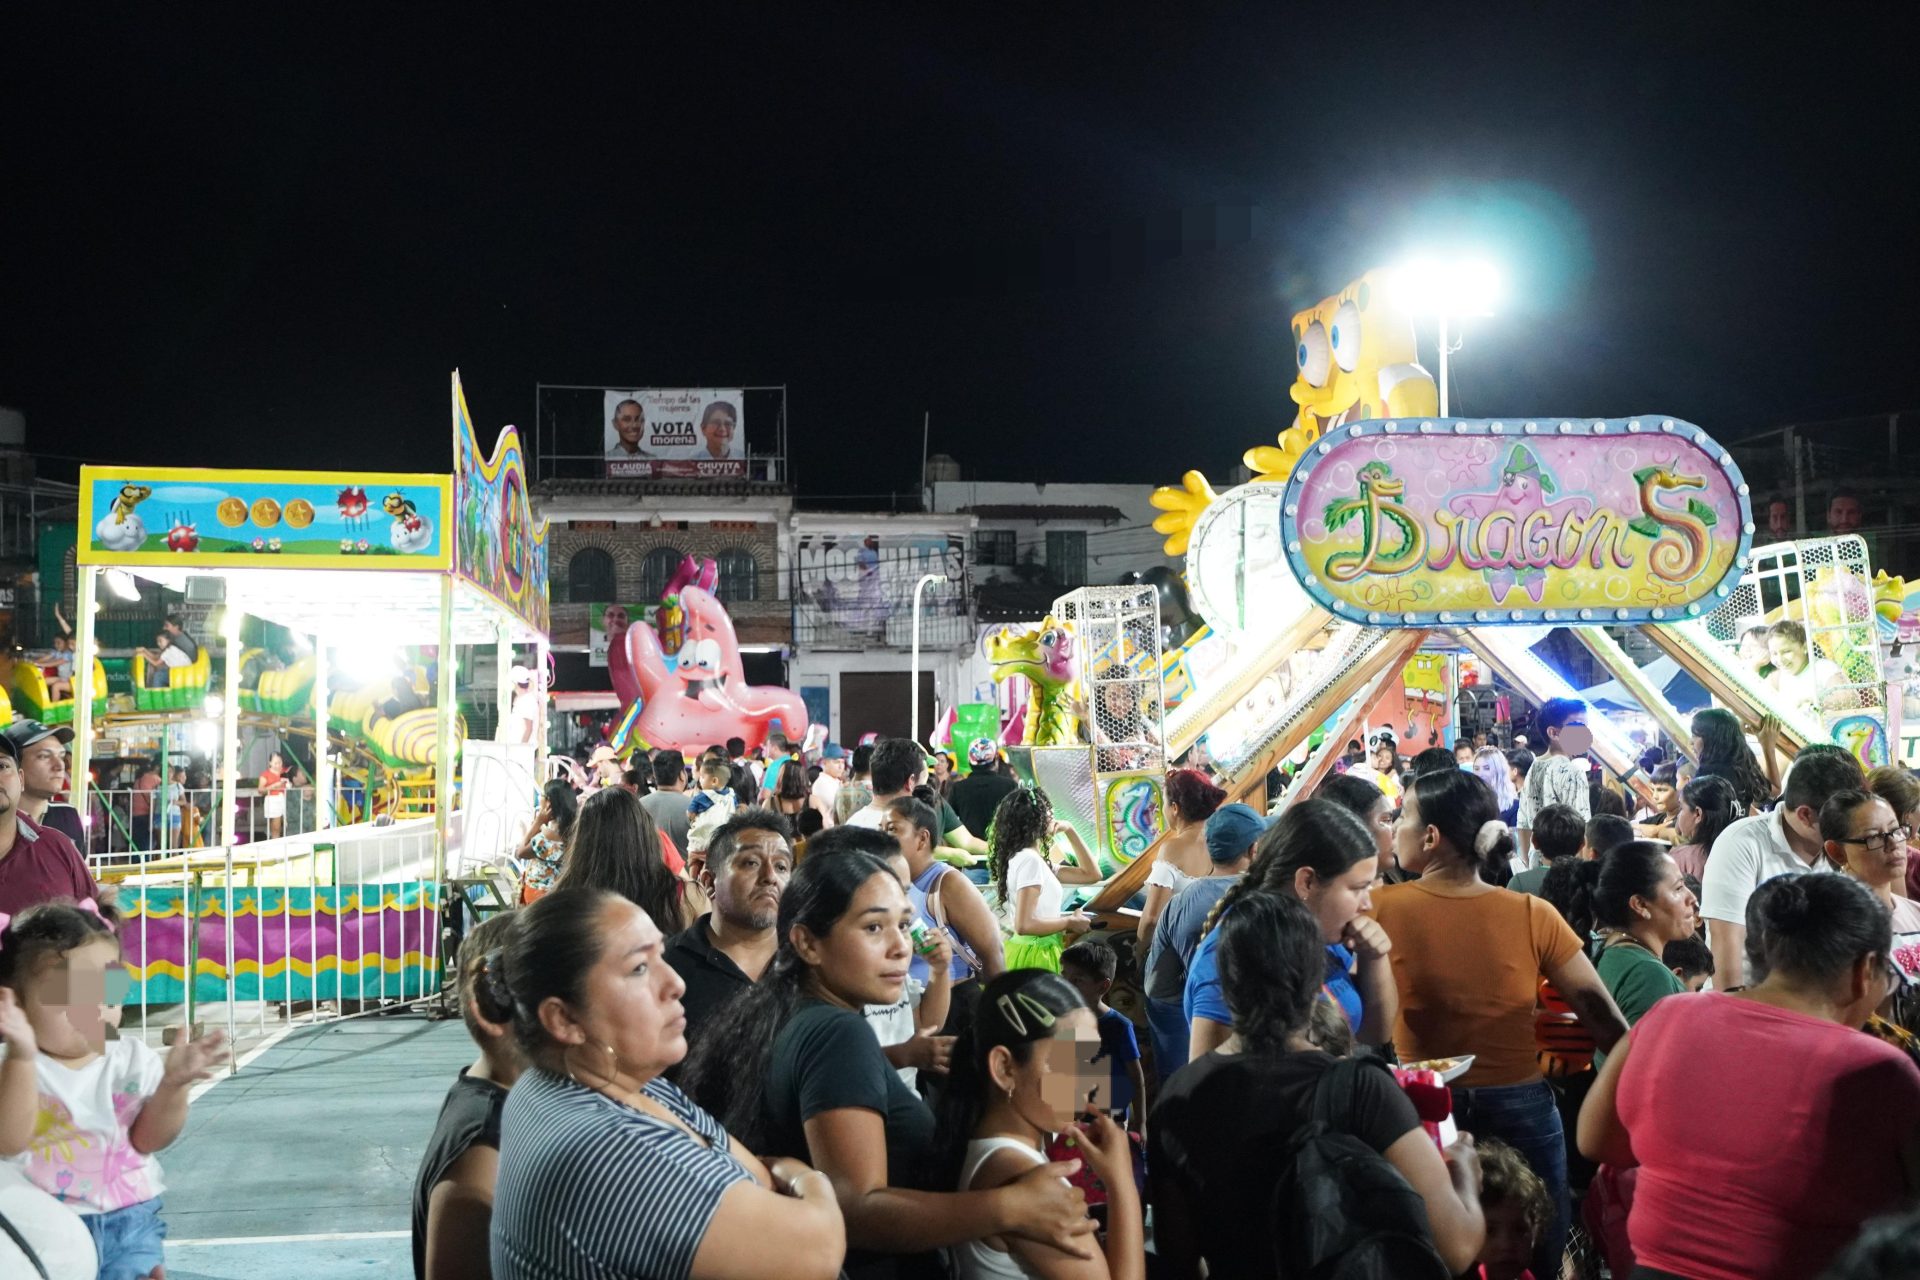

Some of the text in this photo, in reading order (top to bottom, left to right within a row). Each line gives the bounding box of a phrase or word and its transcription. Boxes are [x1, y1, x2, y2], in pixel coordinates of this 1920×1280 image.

[651, 421, 694, 434] VOTA
[652, 436, 695, 444] morena
[610, 462, 652, 470] CLAUDIA
[697, 462, 740, 470] CHUYITA
